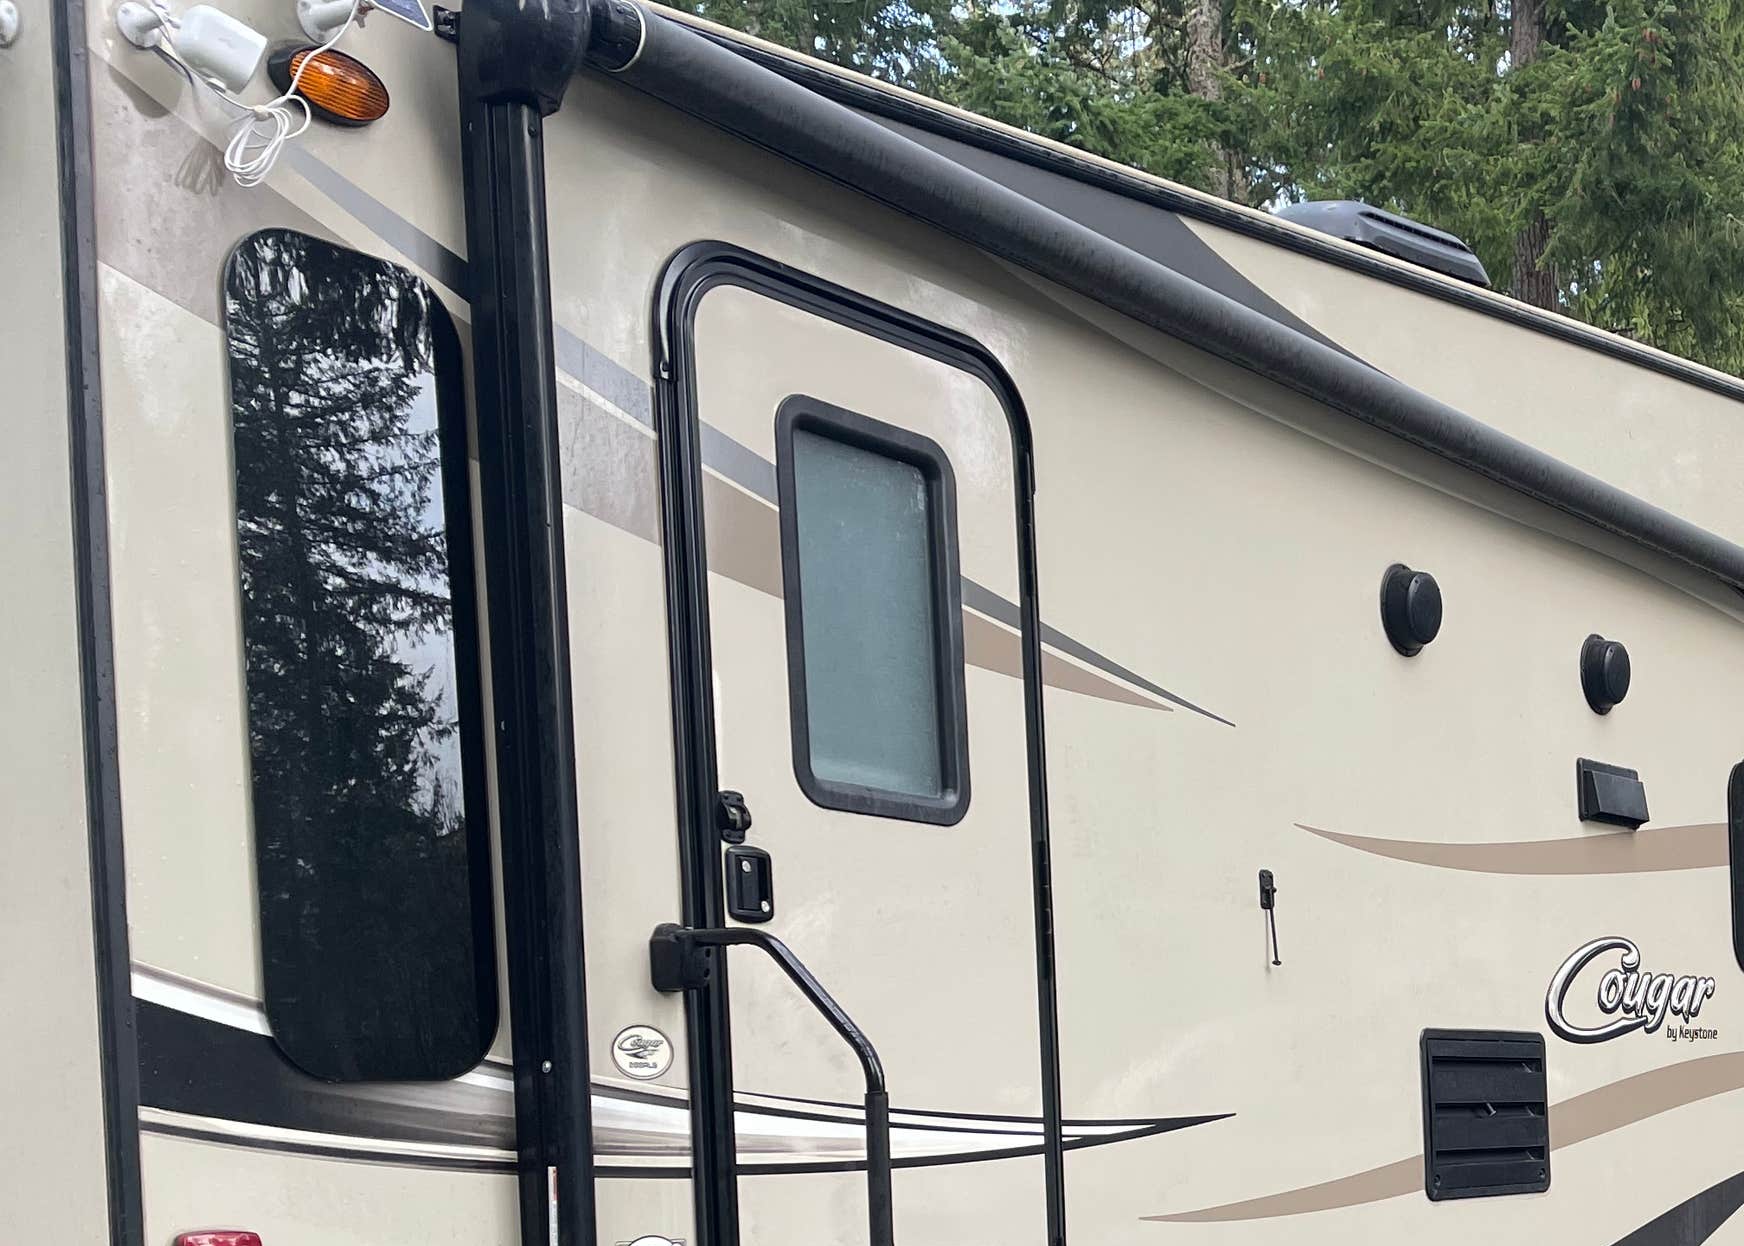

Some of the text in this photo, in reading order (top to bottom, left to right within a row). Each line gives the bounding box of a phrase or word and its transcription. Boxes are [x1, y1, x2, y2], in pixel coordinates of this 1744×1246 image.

[1545, 936, 1715, 1044] Cougar
[1667, 1025, 1718, 1042] by Keystone
